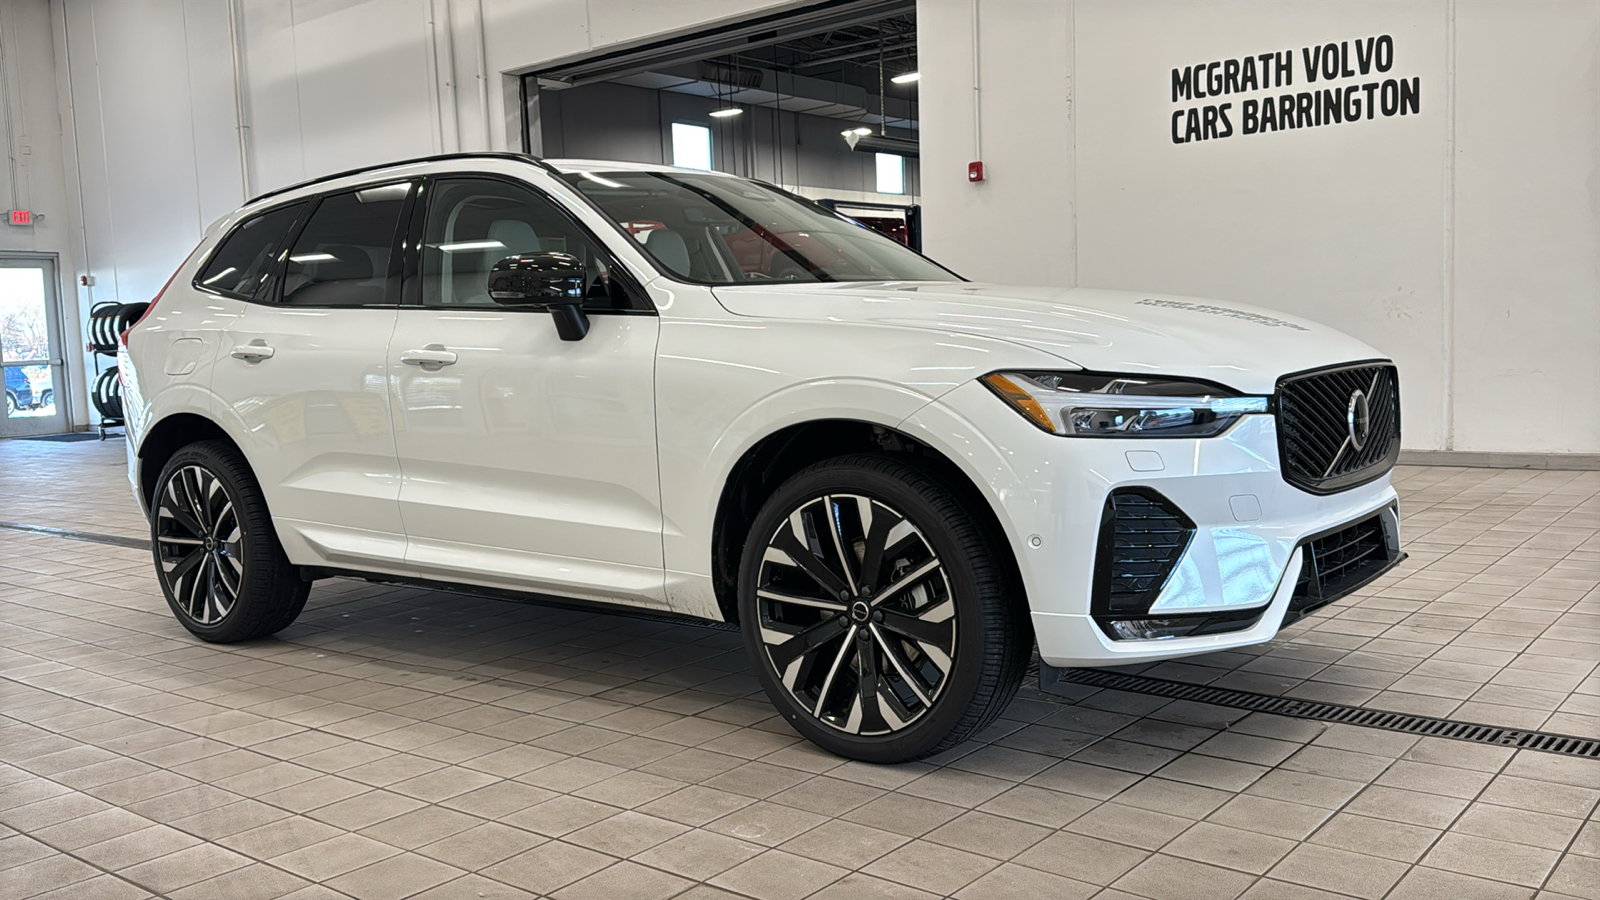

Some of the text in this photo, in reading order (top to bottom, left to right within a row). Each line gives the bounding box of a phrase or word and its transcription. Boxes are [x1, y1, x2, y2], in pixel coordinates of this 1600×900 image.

[1171, 34, 1394, 103] MCGRATH VOLVO
[1171, 76, 1420, 144] CARS BARRINGTON
[13, 210, 30, 223] EXIT
